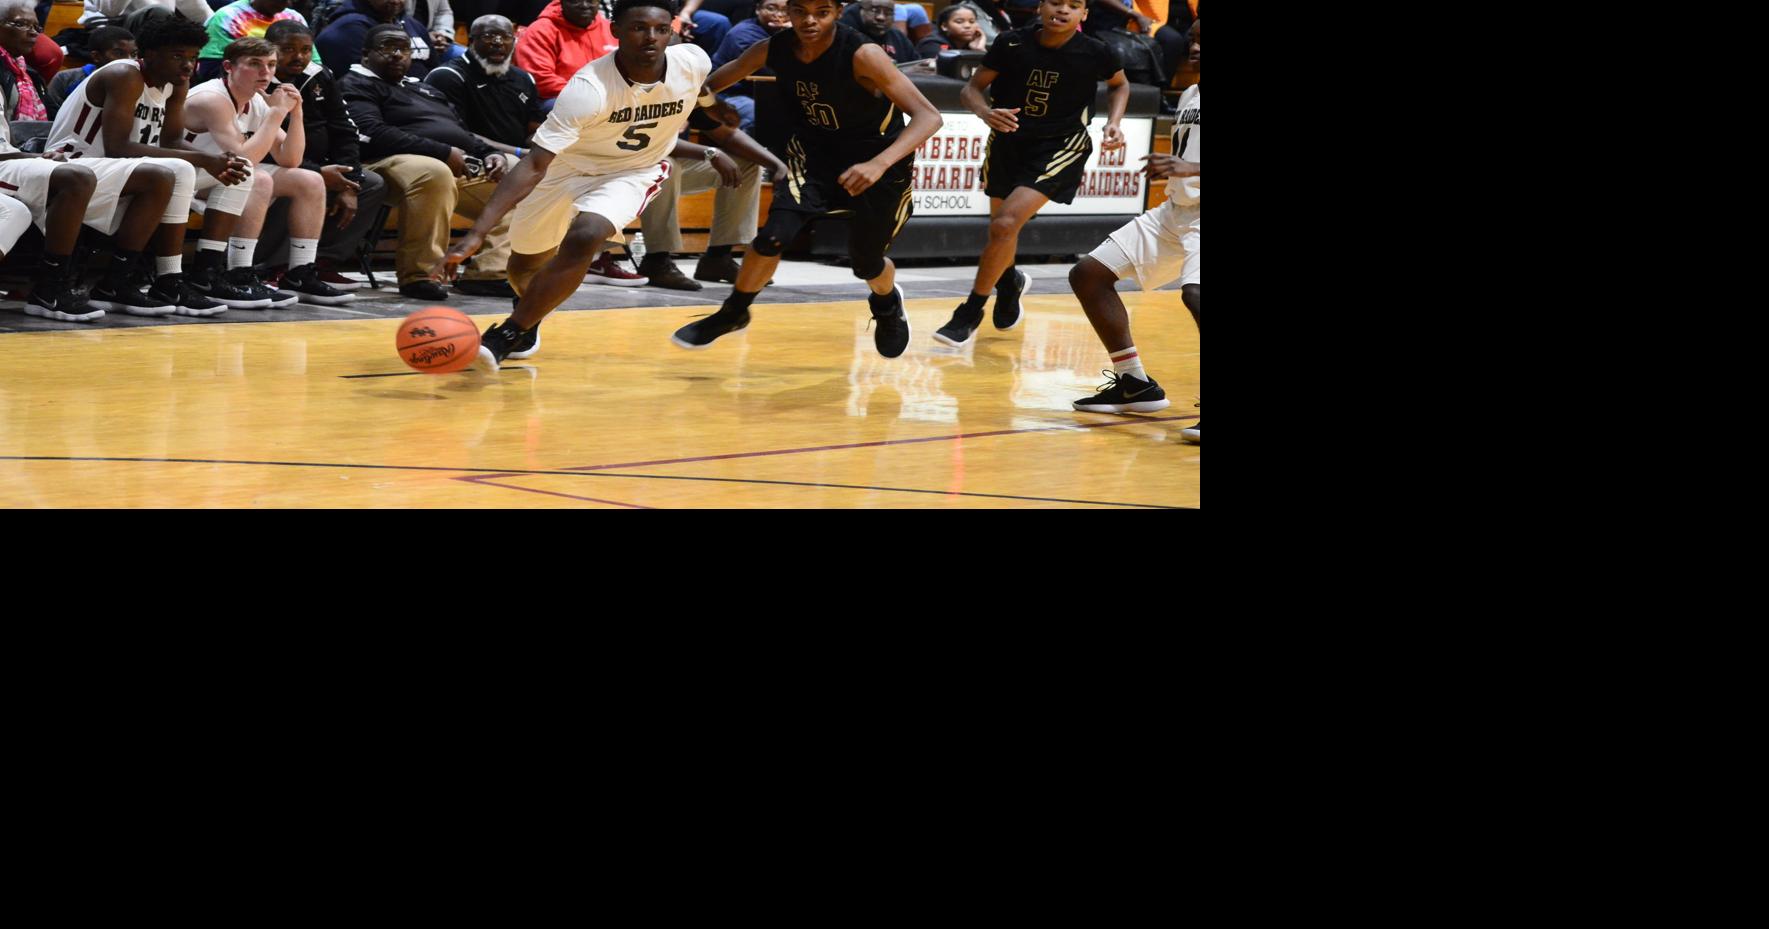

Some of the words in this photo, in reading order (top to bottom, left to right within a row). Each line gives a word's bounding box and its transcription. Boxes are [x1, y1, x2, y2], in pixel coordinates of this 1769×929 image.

[1027, 69, 1060, 88] AF
[607, 106, 632, 123] RED
[634, 99, 684, 122] RAIDERS
[1025, 89, 1050, 117] 5
[616, 122, 658, 151] 5
[1078, 171, 1140, 197] RAIDERS
[924, 195, 972, 209] SCHOOL
